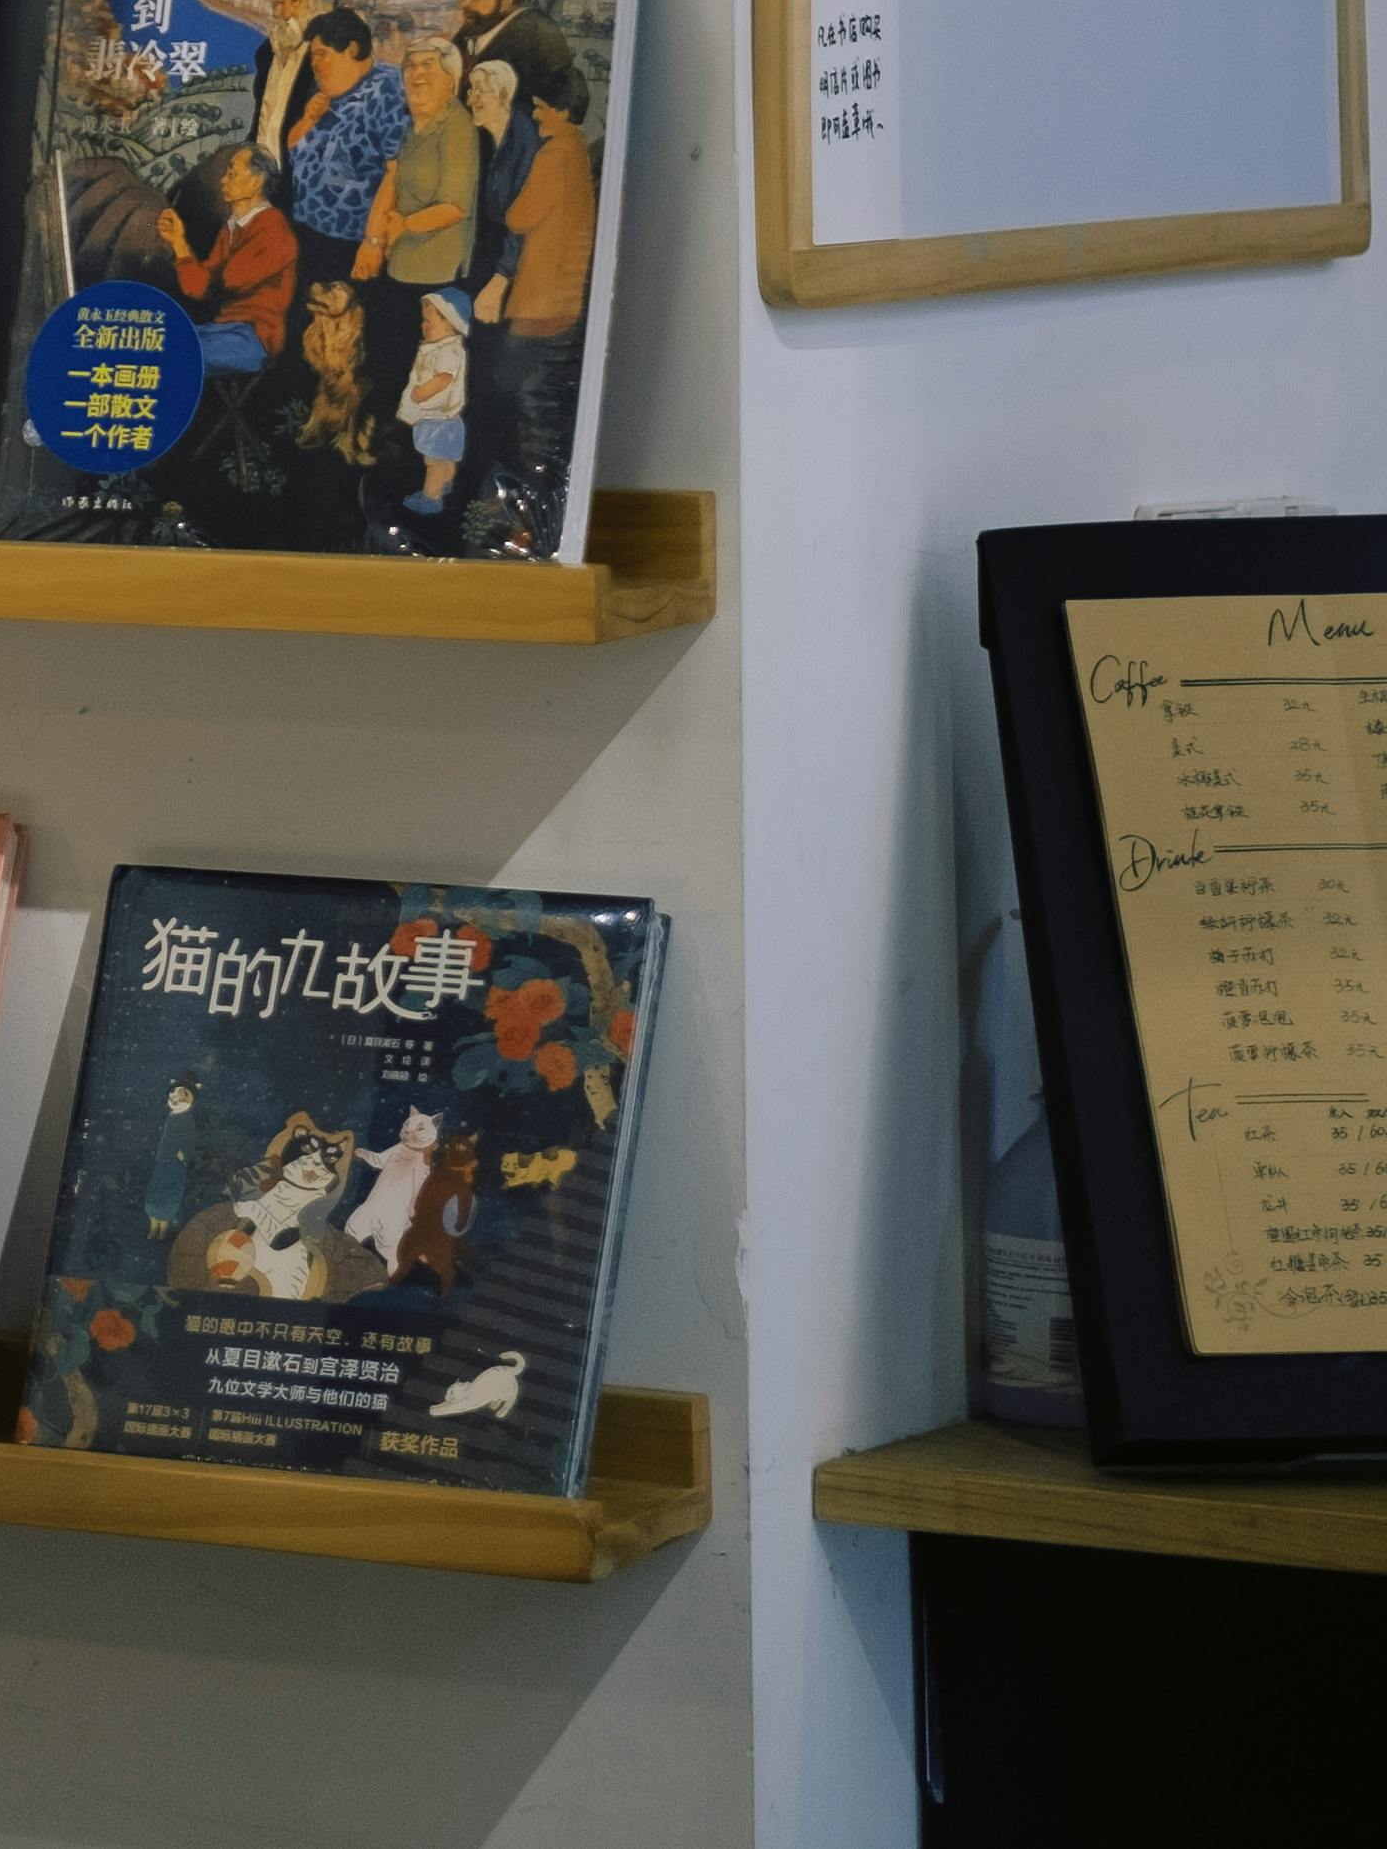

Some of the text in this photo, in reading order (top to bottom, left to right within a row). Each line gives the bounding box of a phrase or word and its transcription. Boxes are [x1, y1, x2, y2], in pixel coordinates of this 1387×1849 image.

[83, 38, 208, 84] 翡冷翠
[72, 324, 166, 351] 全新出版
[67, 362, 161, 390] 一本画册
[63, 393, 158, 420] 一部散文
[60, 422, 154, 451] 一个作者
[1267, 598, 1375, 647] Menu
[1089, 654, 1169, 708] Coffee
[1117, 827, 1213, 892] Drink
[1158, 1076, 1229, 1142] Tea
[205, 1346, 401, 1385] 从夏目漱石到宫泽贤治
[207, 1375, 390, 1412] 九位文学大师与他们的猫
[265, 1412, 364, 1435] ILLUSTRATION
[380, 1430, 460, 1459] 获奖作品
